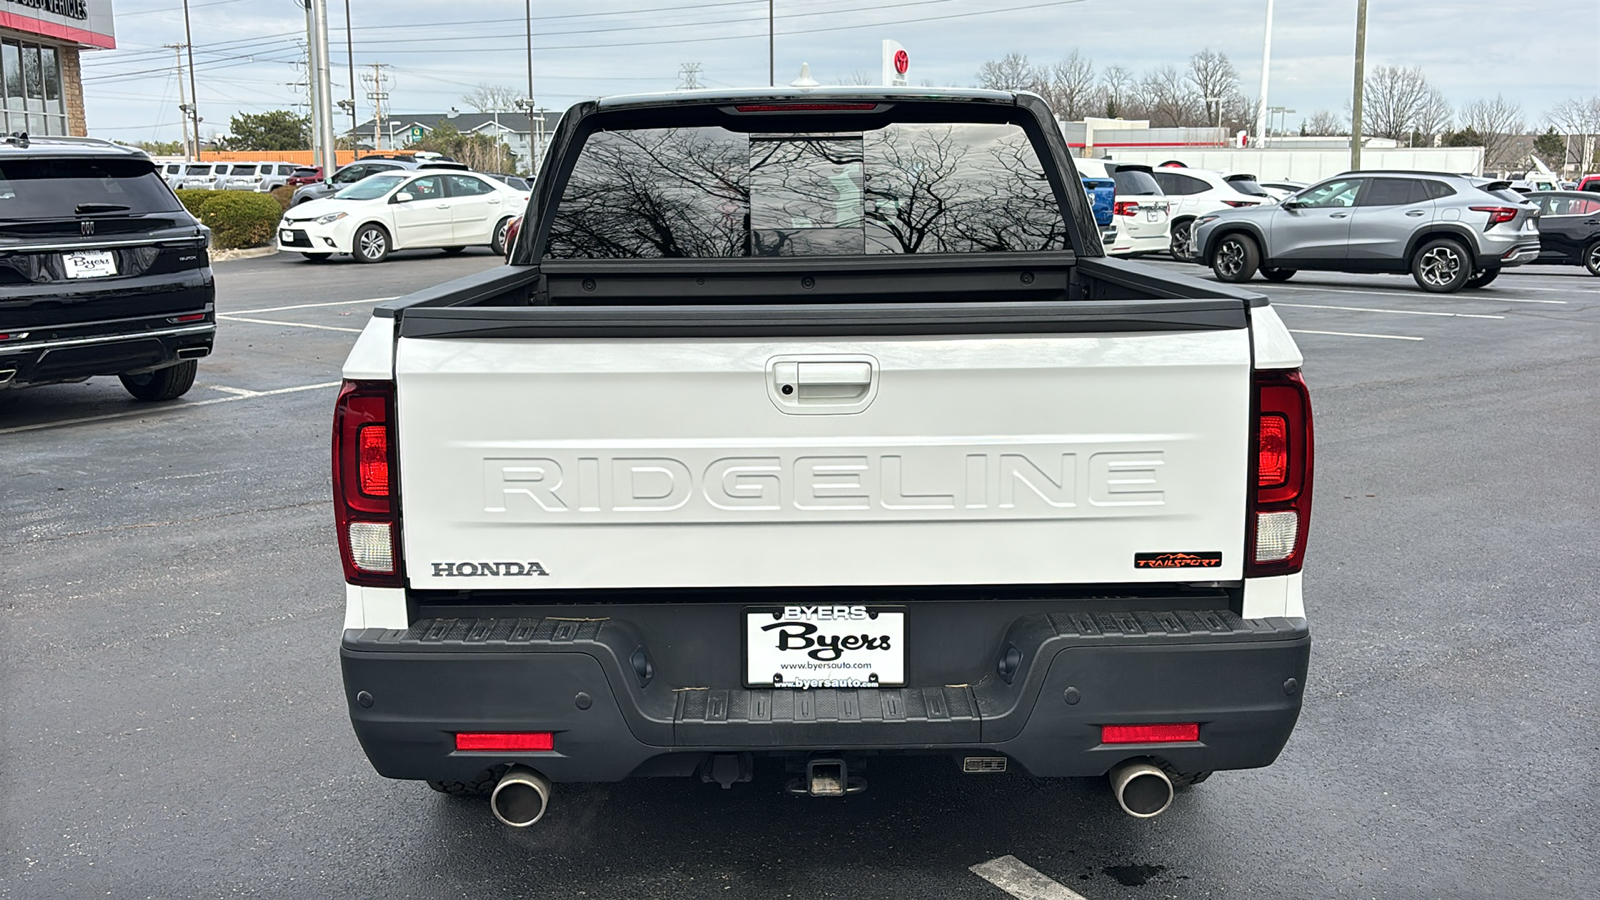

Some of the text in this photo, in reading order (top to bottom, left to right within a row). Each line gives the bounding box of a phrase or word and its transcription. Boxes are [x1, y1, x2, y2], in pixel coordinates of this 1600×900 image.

[47, 0, 88, 20] VEHICLES
[67, 256, 110, 269] Byers
[483, 450, 1166, 512] RIDGELINE
[431, 562, 549, 577] HONDA
[1137, 558, 1220, 567] TRAILSPORT
[784, 605, 867, 620] BYERS
[760, 621, 891, 661] Byers
[780, 661, 872, 671] www.byersauto.com
[774, 677, 879, 690] www.byersauto.com
